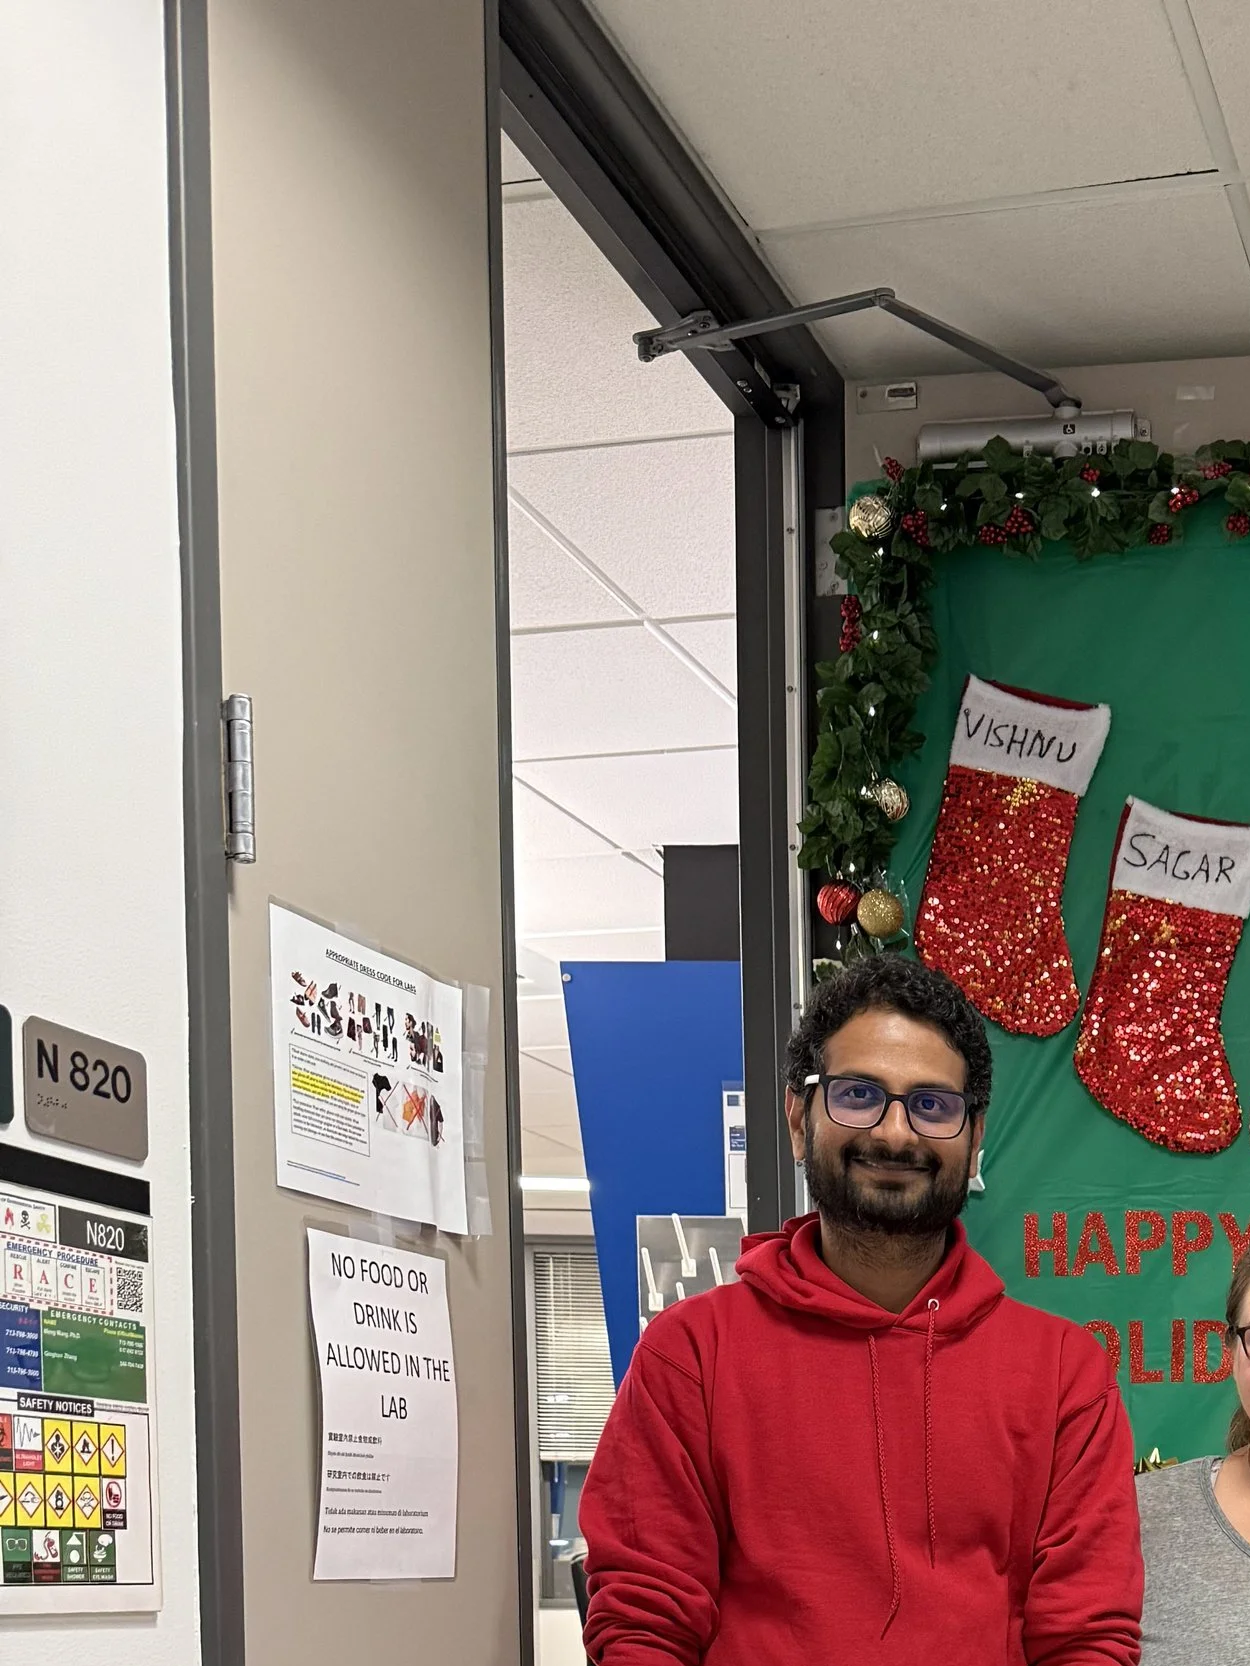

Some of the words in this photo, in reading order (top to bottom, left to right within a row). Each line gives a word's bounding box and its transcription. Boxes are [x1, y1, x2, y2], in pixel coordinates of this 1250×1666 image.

[963, 707, 1078, 764] VISHNU
[1122, 832, 1237, 885] SAGAR
[359, 963, 376, 977] DRESS
[376, 971, 392, 983] CODE
[392, 977, 403, 987] FOR
[404, 982, 417, 993] LABS
[37, 1038, 59, 1083] N
[69, 1051, 131, 1104] 820
[86, 1220, 125, 1252] N820
[6, 1241, 53, 1257] EMERGENCY
[57, 1251, 99, 1267] PROCEDURE
[13, 1263, 24, 1280] R
[39, 1269, 49, 1285] A
[64, 1273, 74, 1289] C
[89, 1278, 98, 1294] E
[331, 1252, 355, 1279] NO
[360, 1258, 404, 1289] FOOD
[407, 1269, 429, 1295] OR
[50, 1309, 97, 1324] EMERGENCY
[98, 1318, 137, 1331] CONTACTS
[353, 1302, 402, 1333] DRINK
[404, 1311, 418, 1335] IS
[326, 1342, 401, 1375] ALLOWED
[404, 1353, 421, 1378] IN
[423, 1356, 451, 1382] THE
[1083, 1317, 1234, 1384] OLID
[19, 1396, 53, 1409] SAFETY
[55, 1400, 93, 1414] NOTICES
[381, 1394, 408, 1420] LAB
